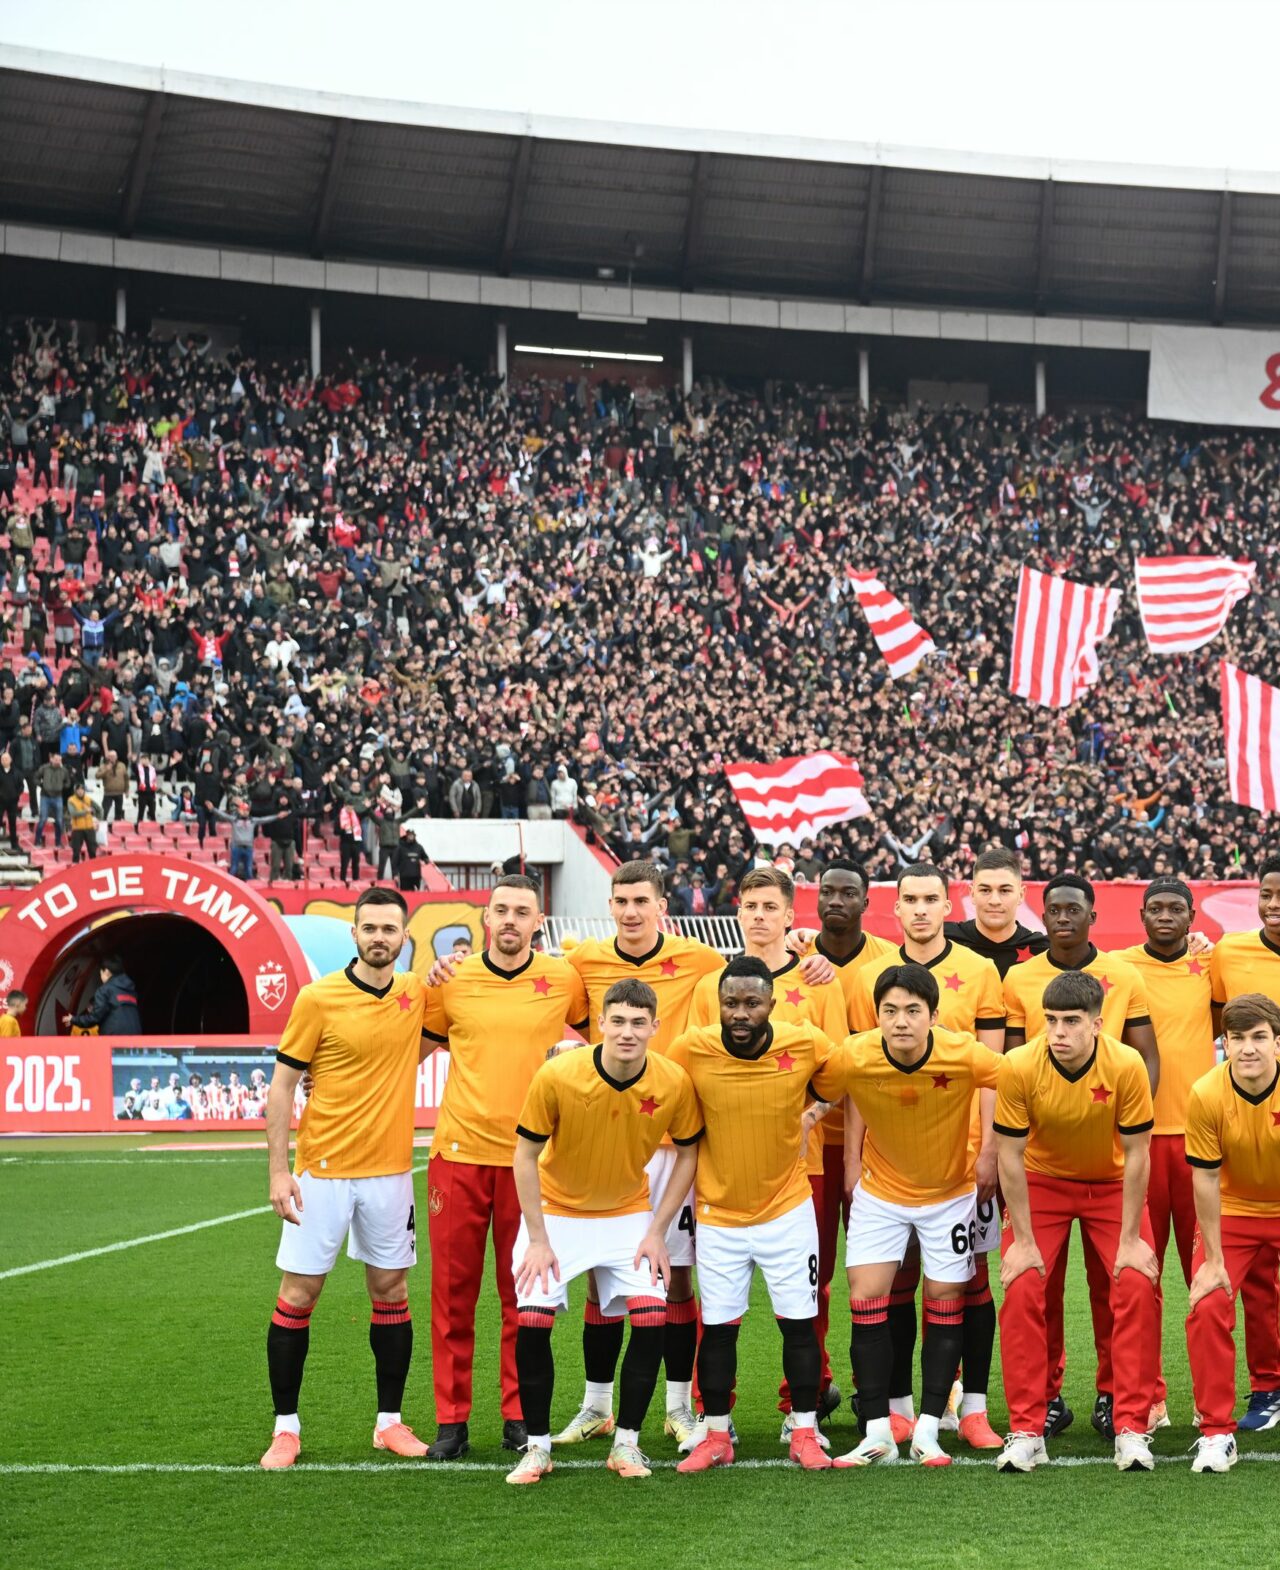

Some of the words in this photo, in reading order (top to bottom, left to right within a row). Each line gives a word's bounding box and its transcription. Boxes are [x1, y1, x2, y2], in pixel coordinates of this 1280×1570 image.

[17, 882, 78, 931] ТО
[161, 868, 259, 940] ТИМ!
[5, 1055, 91, 1113] 2025.
[808, 1253, 818, 1287] 8
